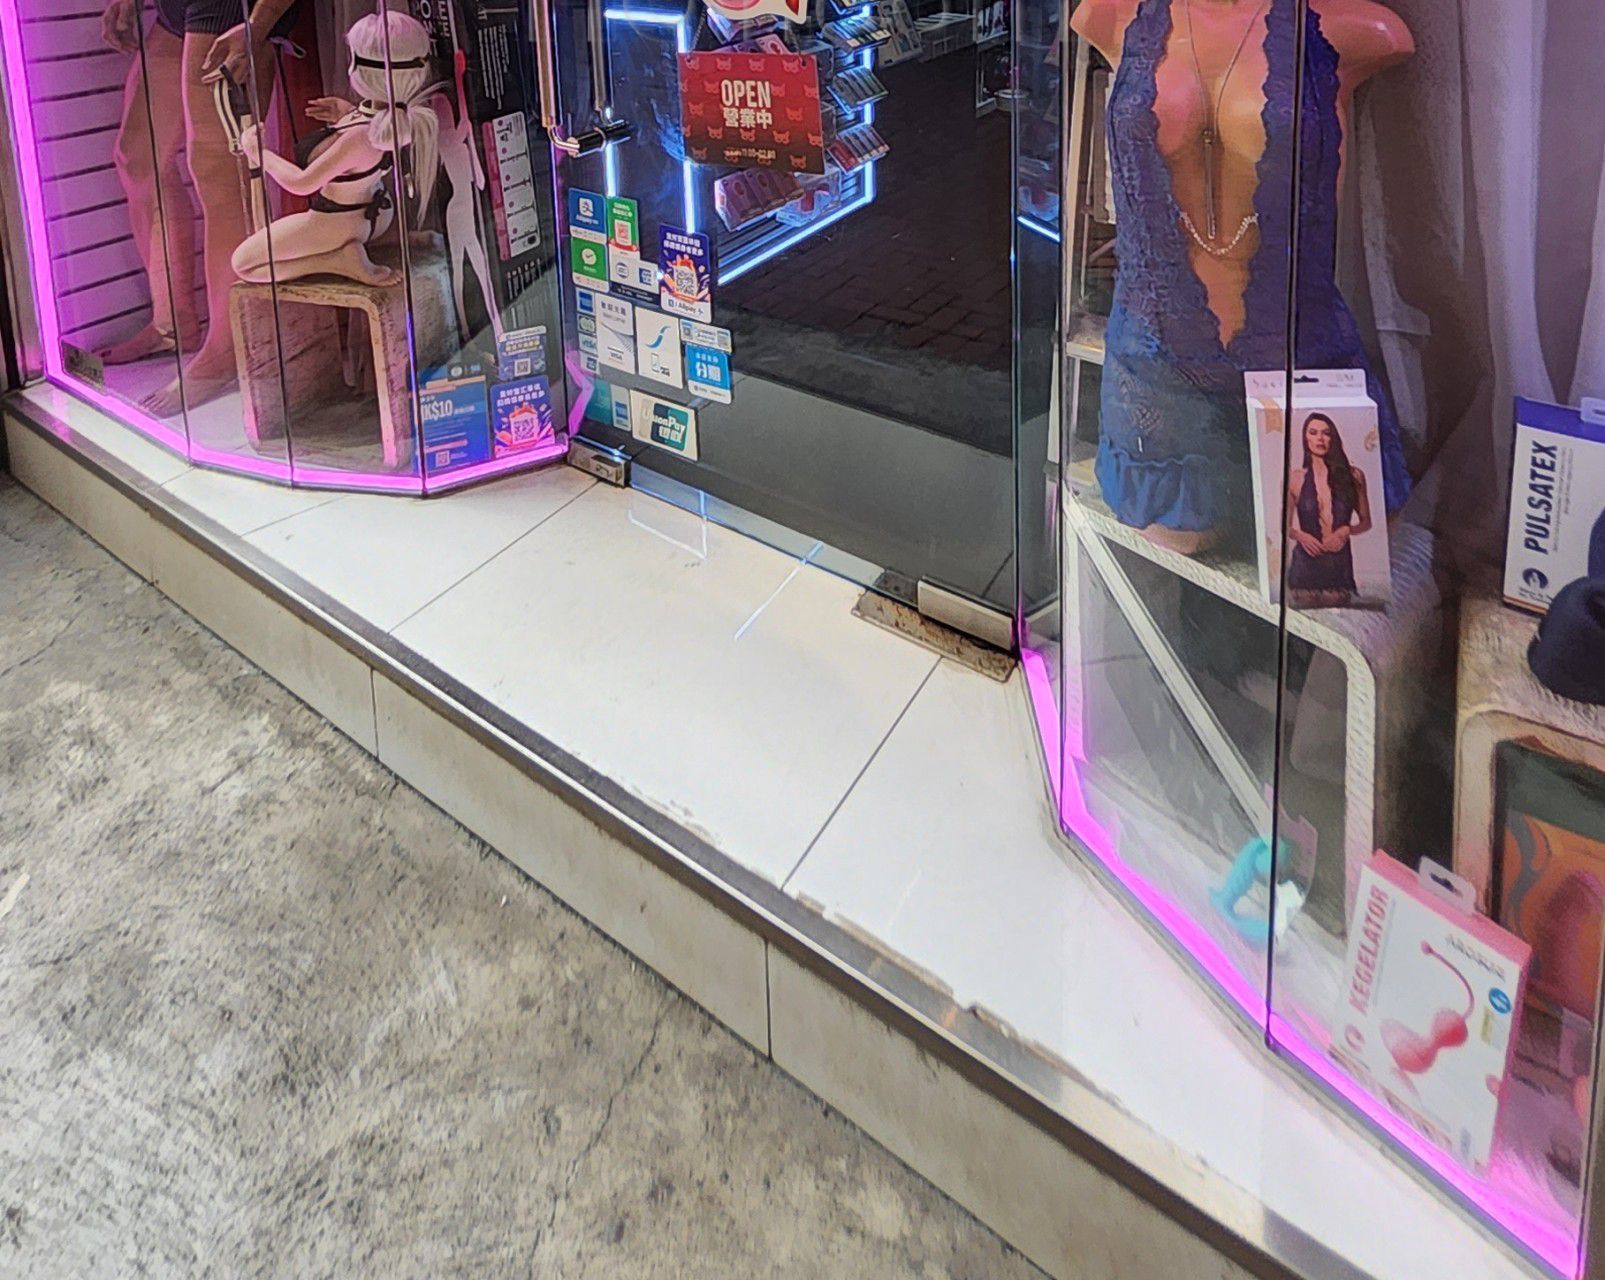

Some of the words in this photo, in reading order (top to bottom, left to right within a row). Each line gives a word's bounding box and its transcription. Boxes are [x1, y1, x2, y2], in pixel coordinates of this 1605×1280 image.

[721, 80, 772, 108] OPEN
[722, 108, 773, 129] 營業中
[1523, 439, 1559, 555] PULSATEX
[1347, 883, 1391, 1017] KEGELATOR
